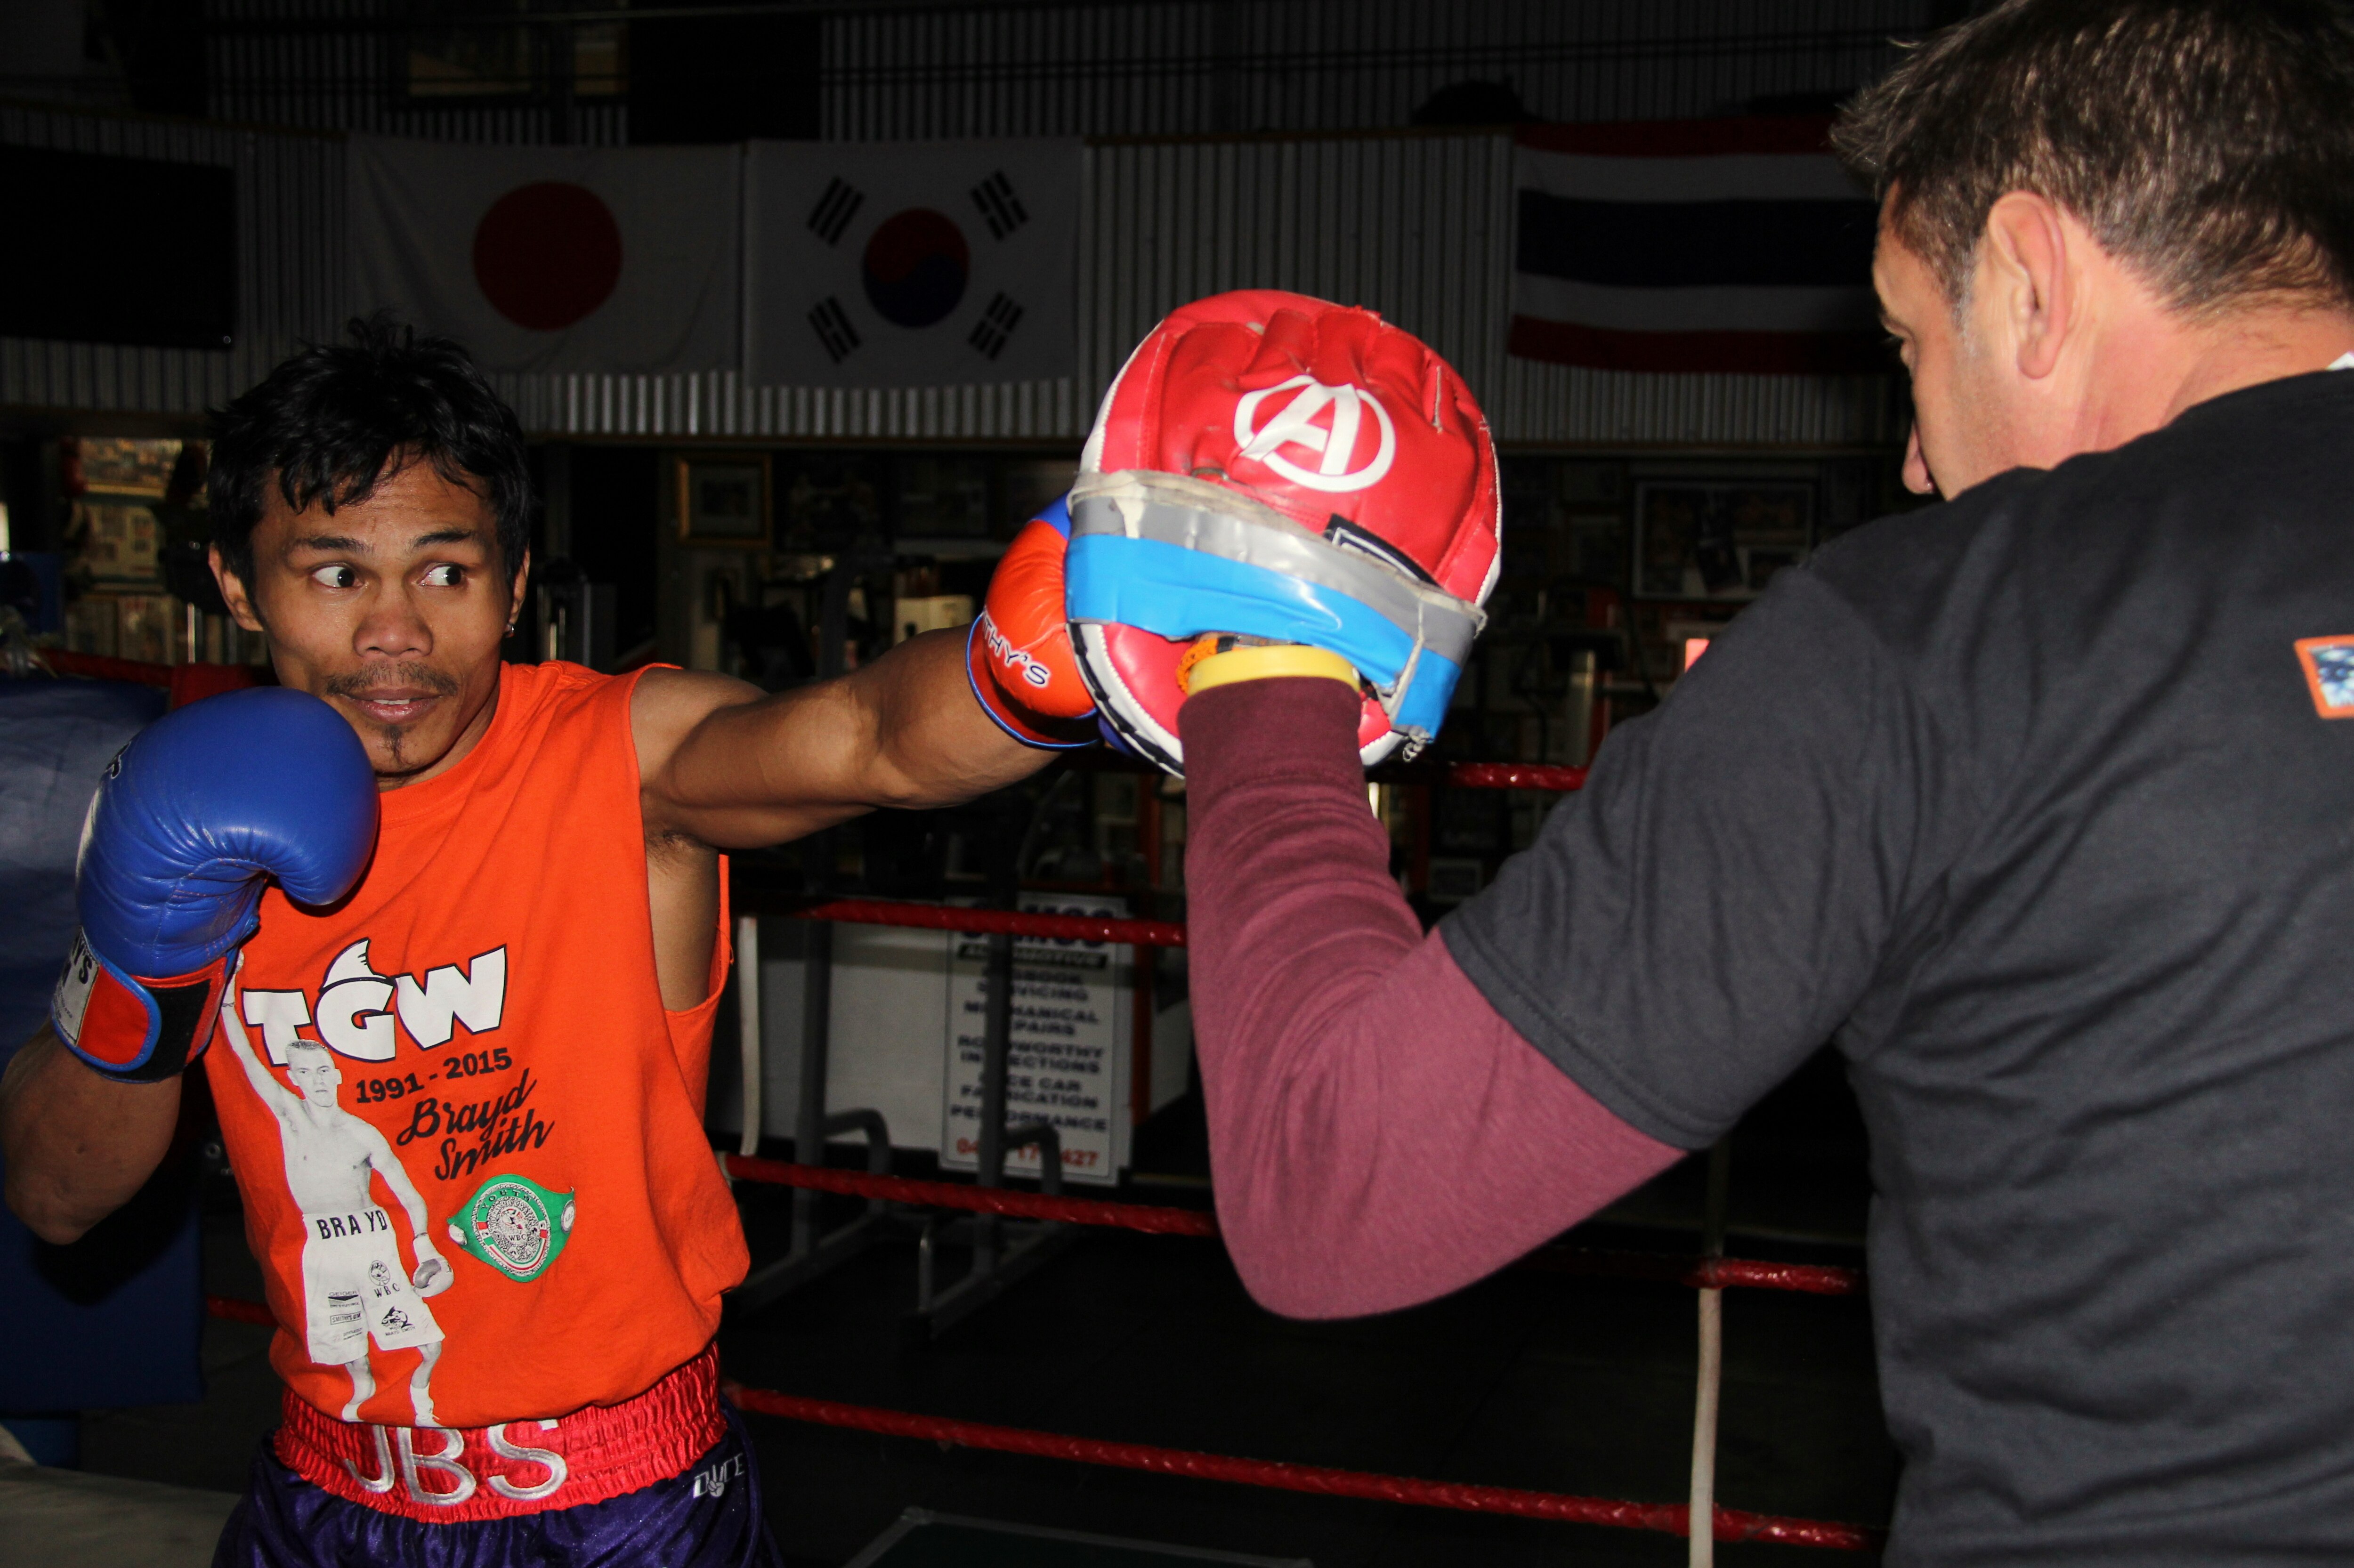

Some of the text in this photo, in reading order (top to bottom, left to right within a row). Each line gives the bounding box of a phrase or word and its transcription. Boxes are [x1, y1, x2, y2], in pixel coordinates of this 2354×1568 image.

[242, 942, 507, 1067] TGW
[356, 1073, 425, 1104] 1991
[443, 1047, 513, 1080] 2015
[396, 1067, 537, 1146] Brayd
[434, 1108, 555, 1181] Smith
[509, 1233, 527, 1241] WBC
[373, 1283, 400, 1298] WBC
